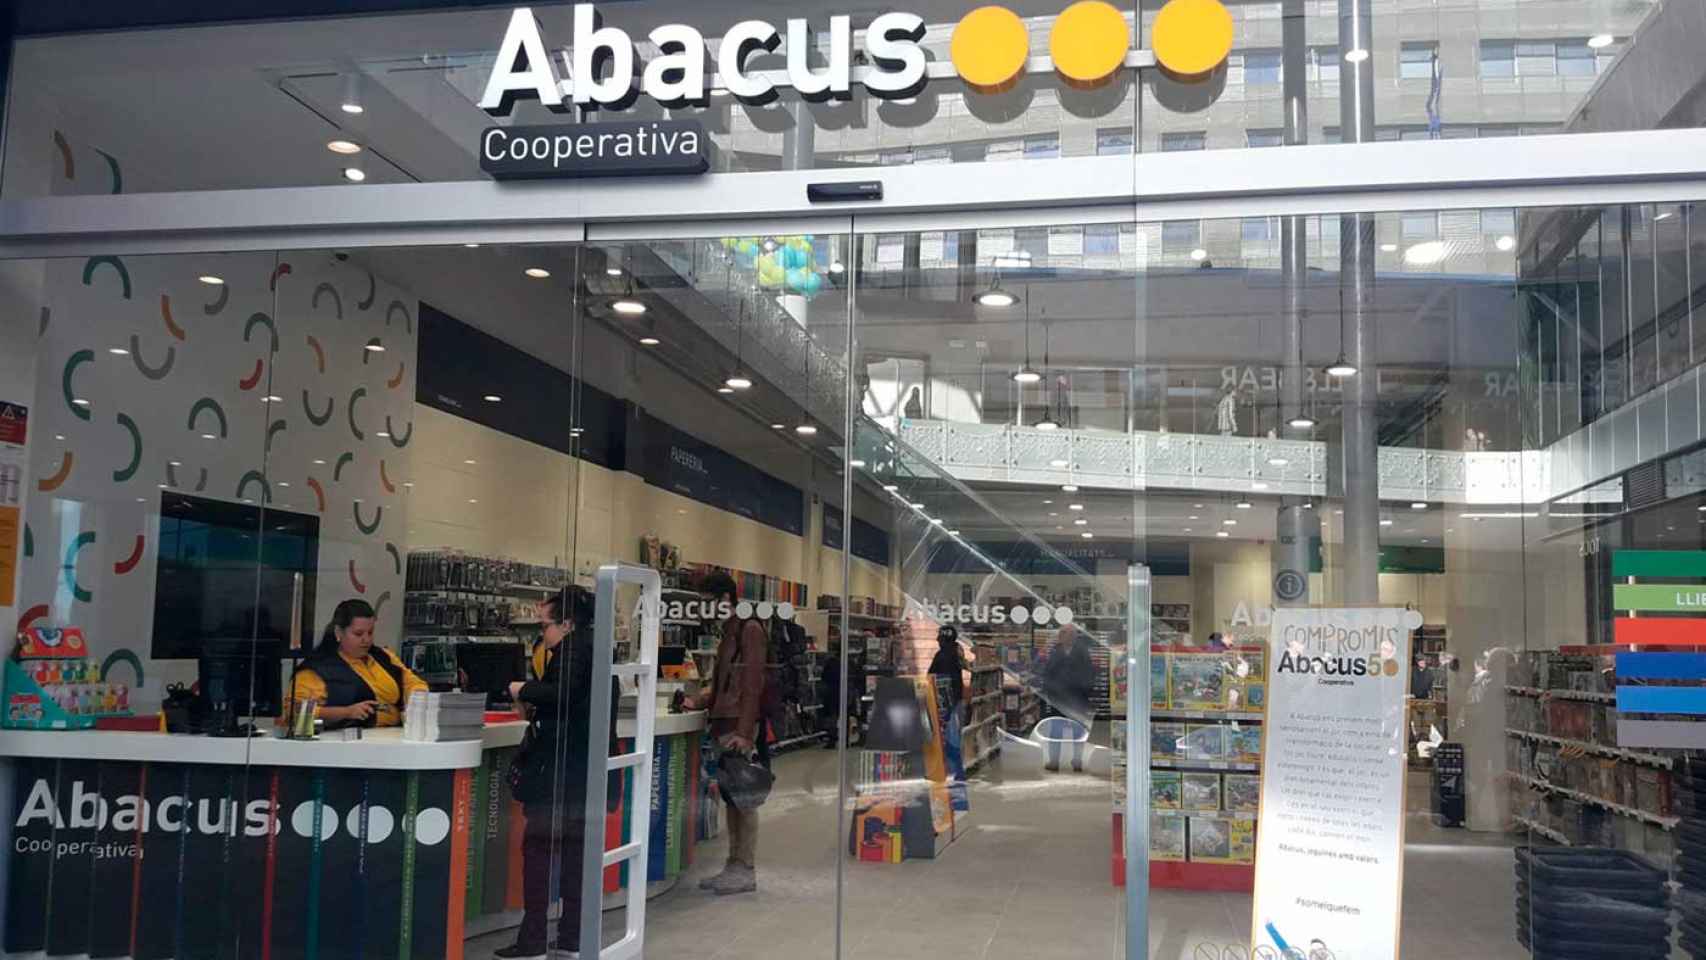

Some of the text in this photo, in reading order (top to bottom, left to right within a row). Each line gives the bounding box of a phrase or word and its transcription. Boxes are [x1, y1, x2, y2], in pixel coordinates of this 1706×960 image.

[480, 3, 926, 111] Abacus
[484, 124, 699, 167] Cooperativa
[16, 779, 282, 838] Abacus
